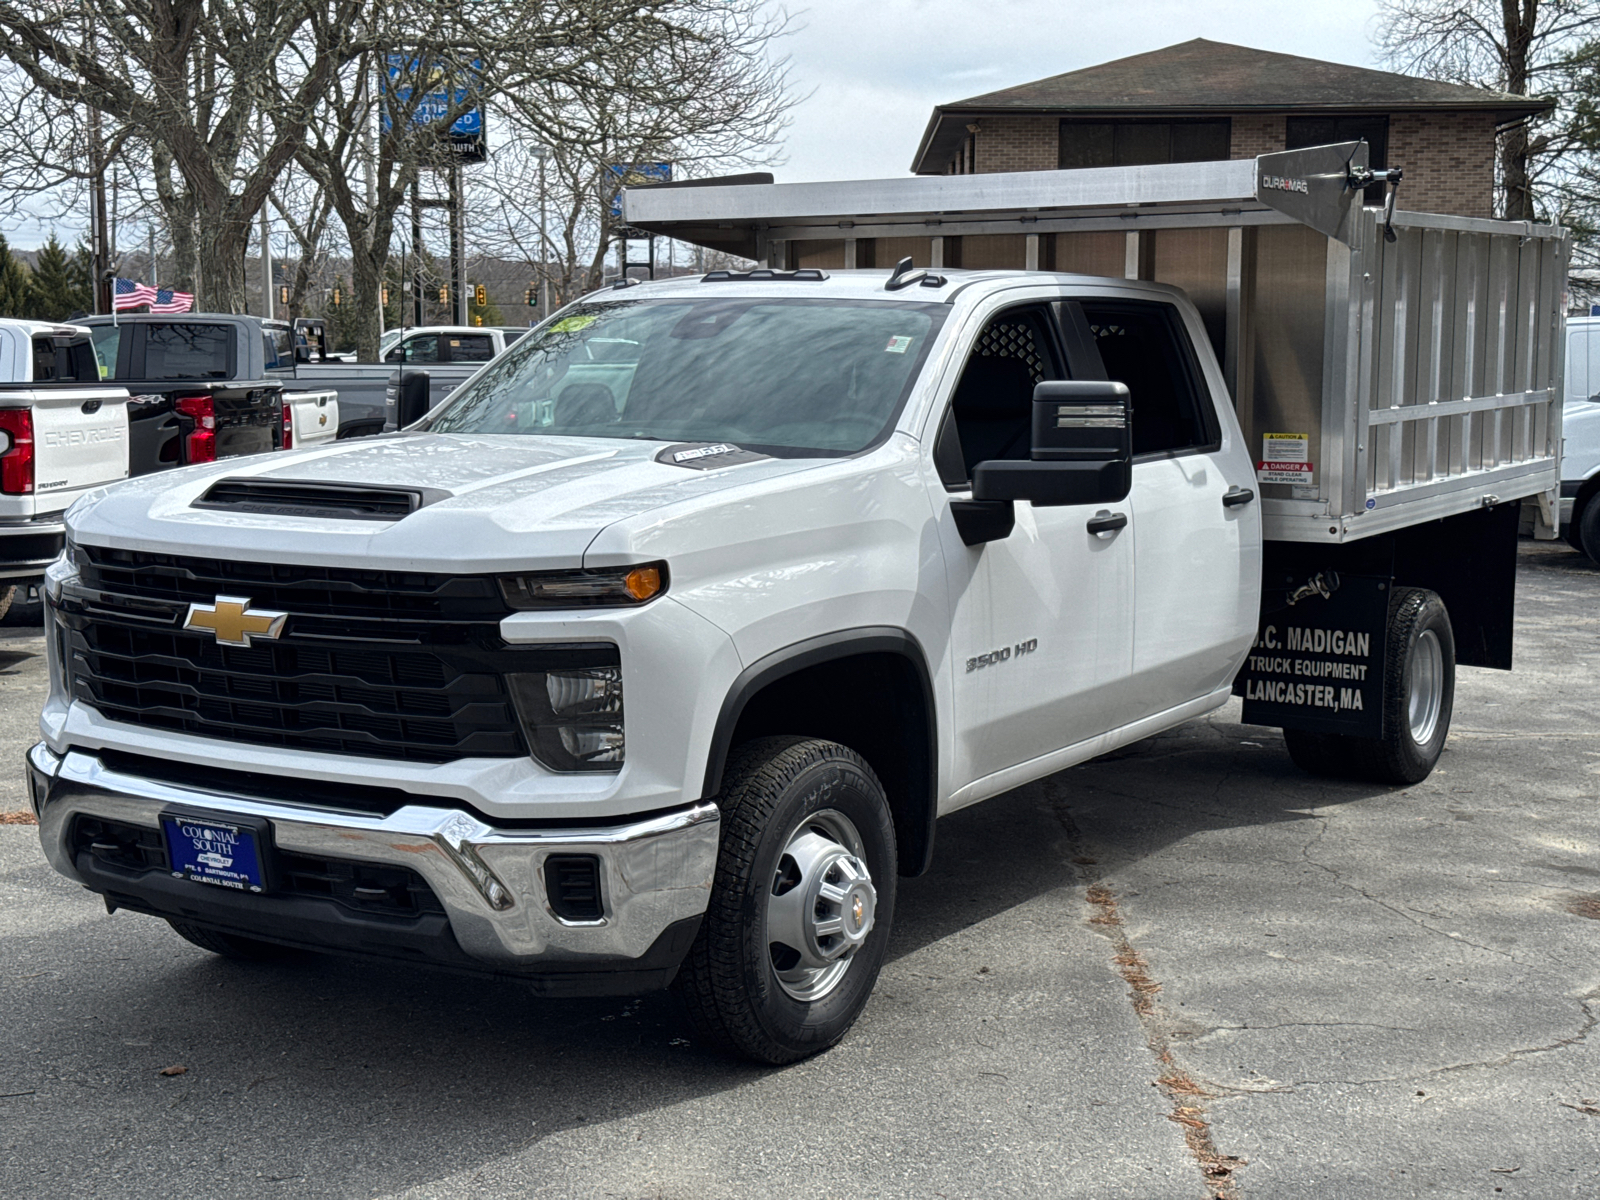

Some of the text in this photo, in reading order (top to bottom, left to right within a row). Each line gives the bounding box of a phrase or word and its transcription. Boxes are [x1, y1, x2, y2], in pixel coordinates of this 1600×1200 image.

[44, 425, 126, 449] CHEVROLET
[1270, 463, 1300, 471] DANGER
[241, 504, 338, 518] CHEVROLET
[1287, 627, 1370, 657] MADIGAN
[966, 638, 1038, 674] 3500 HD
[1250, 655, 1368, 681] TRUCK EQUIPMENT
[182, 825, 239, 845] COLONIAL
[193, 839, 232, 855] SOUTH
[200, 856, 230, 865] CHEVROLET
[222, 879, 243, 889] SOUTH
